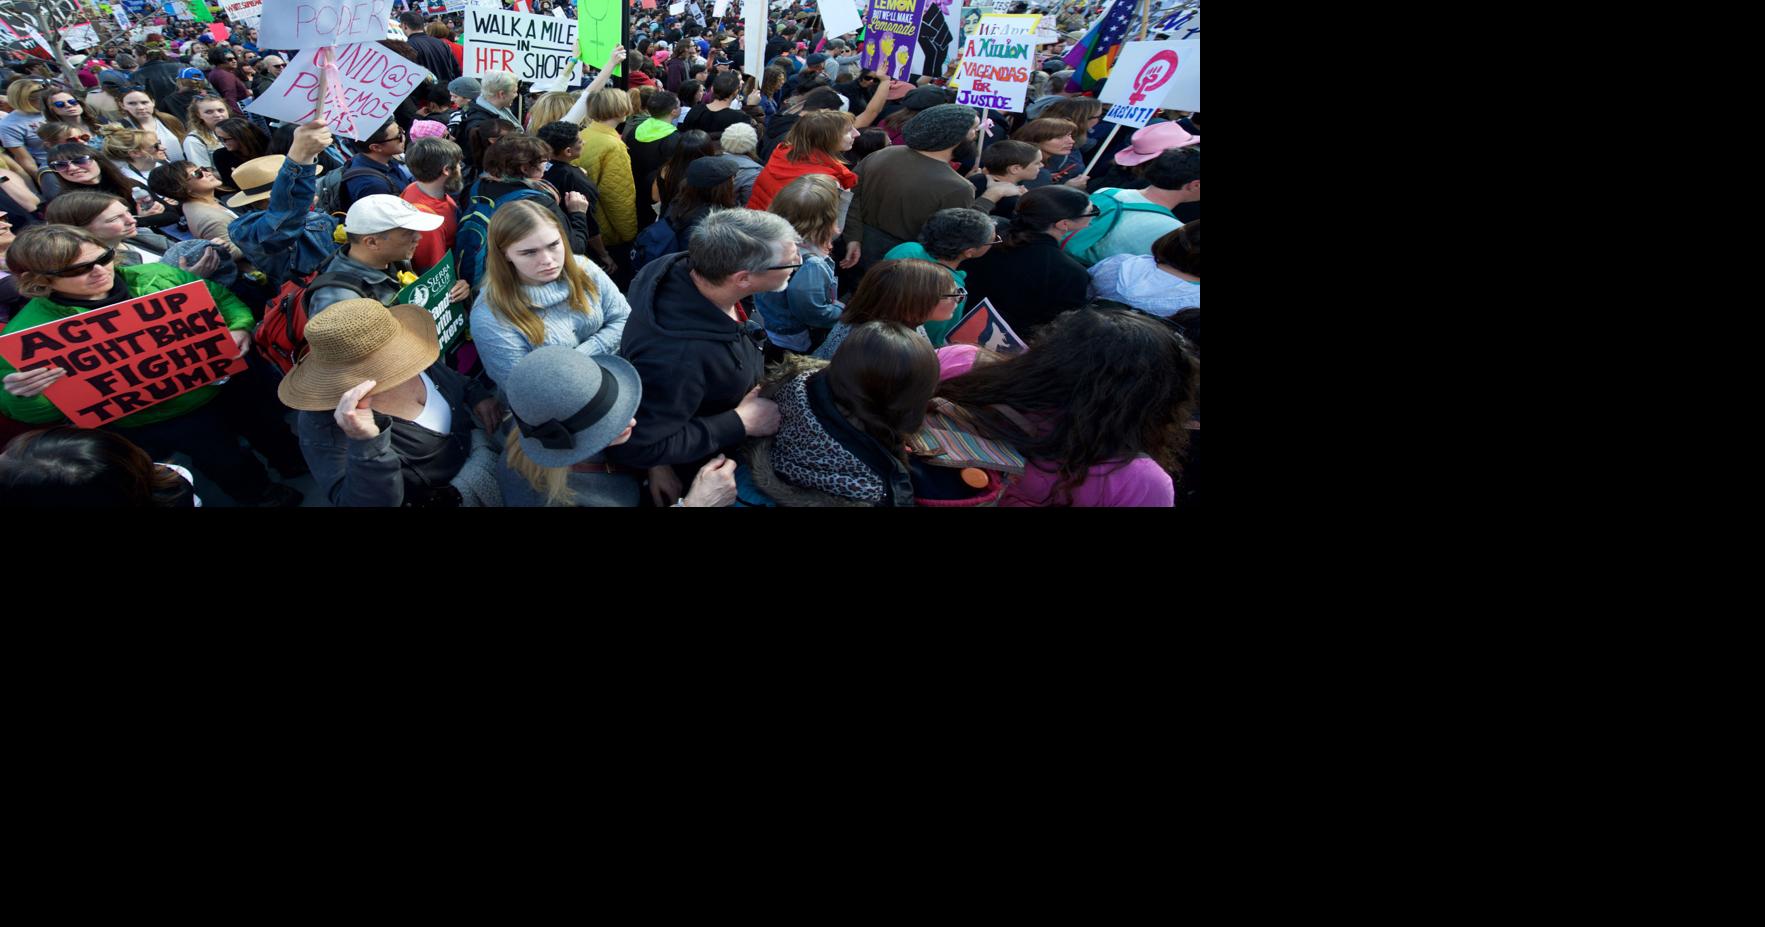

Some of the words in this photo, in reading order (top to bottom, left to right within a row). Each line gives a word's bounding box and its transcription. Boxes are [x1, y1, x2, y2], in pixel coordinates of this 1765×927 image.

[873, 0, 915, 12] LEMON
[897, 12, 914, 23] MAKE
[296, 0, 384, 39] PODER
[472, 11, 522, 37] WALK
[525, 19, 536, 39] A
[541, 21, 577, 45] MILE
[868, 16, 916, 36] Lemonade
[517, 40, 530, 51] IN
[965, 40, 976, 57] A
[476, 47, 514, 73] HER
[522, 53, 576, 82] SHOES
[962, 62, 1029, 83] VAGENDAS
[972, 79, 992, 93] FOR
[957, 90, 1013, 110] JUSTICE
[427, 263, 450, 288] SIERRA
[431, 273, 451, 293] CLUB
[132, 292, 188, 322] UP
[430, 291, 451, 320] and
[439, 313, 465, 351] rkers
[85, 333, 226, 397] FIGHT
[77, 358, 233, 422] TRUMP
